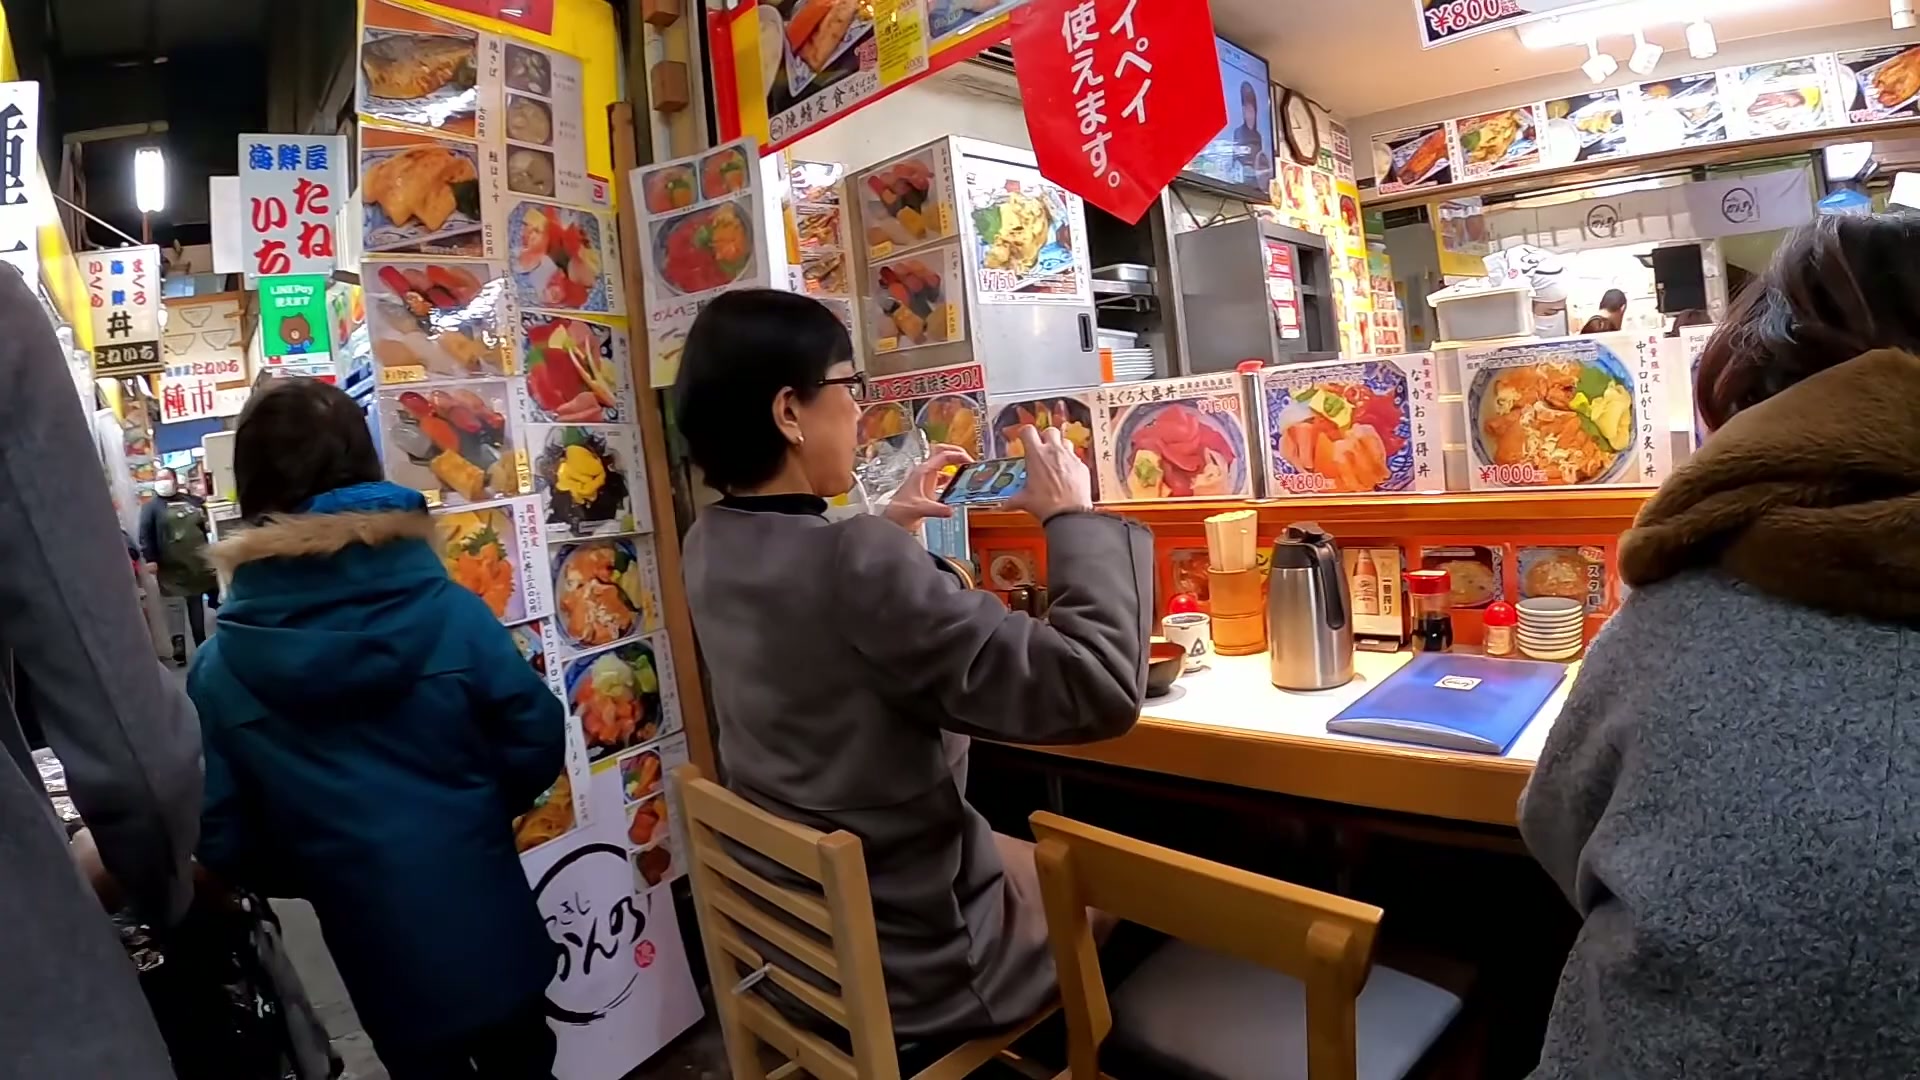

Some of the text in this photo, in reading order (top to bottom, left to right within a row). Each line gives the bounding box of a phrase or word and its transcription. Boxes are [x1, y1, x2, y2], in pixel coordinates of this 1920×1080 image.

[1431, 0, 1501, 34] ¥800
[1109, 0, 1153, 124] イペイ
[1061, 0, 1121, 188] 使えます。
[249, 143, 328, 171] 海鮮屋
[250, 196, 291, 275] いち
[292, 177, 333, 259] たね
[162, 379, 215, 420] 種市
[1109, 384, 1177, 405] まぐろ大盛丼
[1411, 369, 1431, 478] なかおち得丼
[1635, 340, 1657, 478] 中トロはがしの炙り丼
[1279, 474, 1324, 490] ¥1800
[1479, 465, 1533, 483] ¥1000
